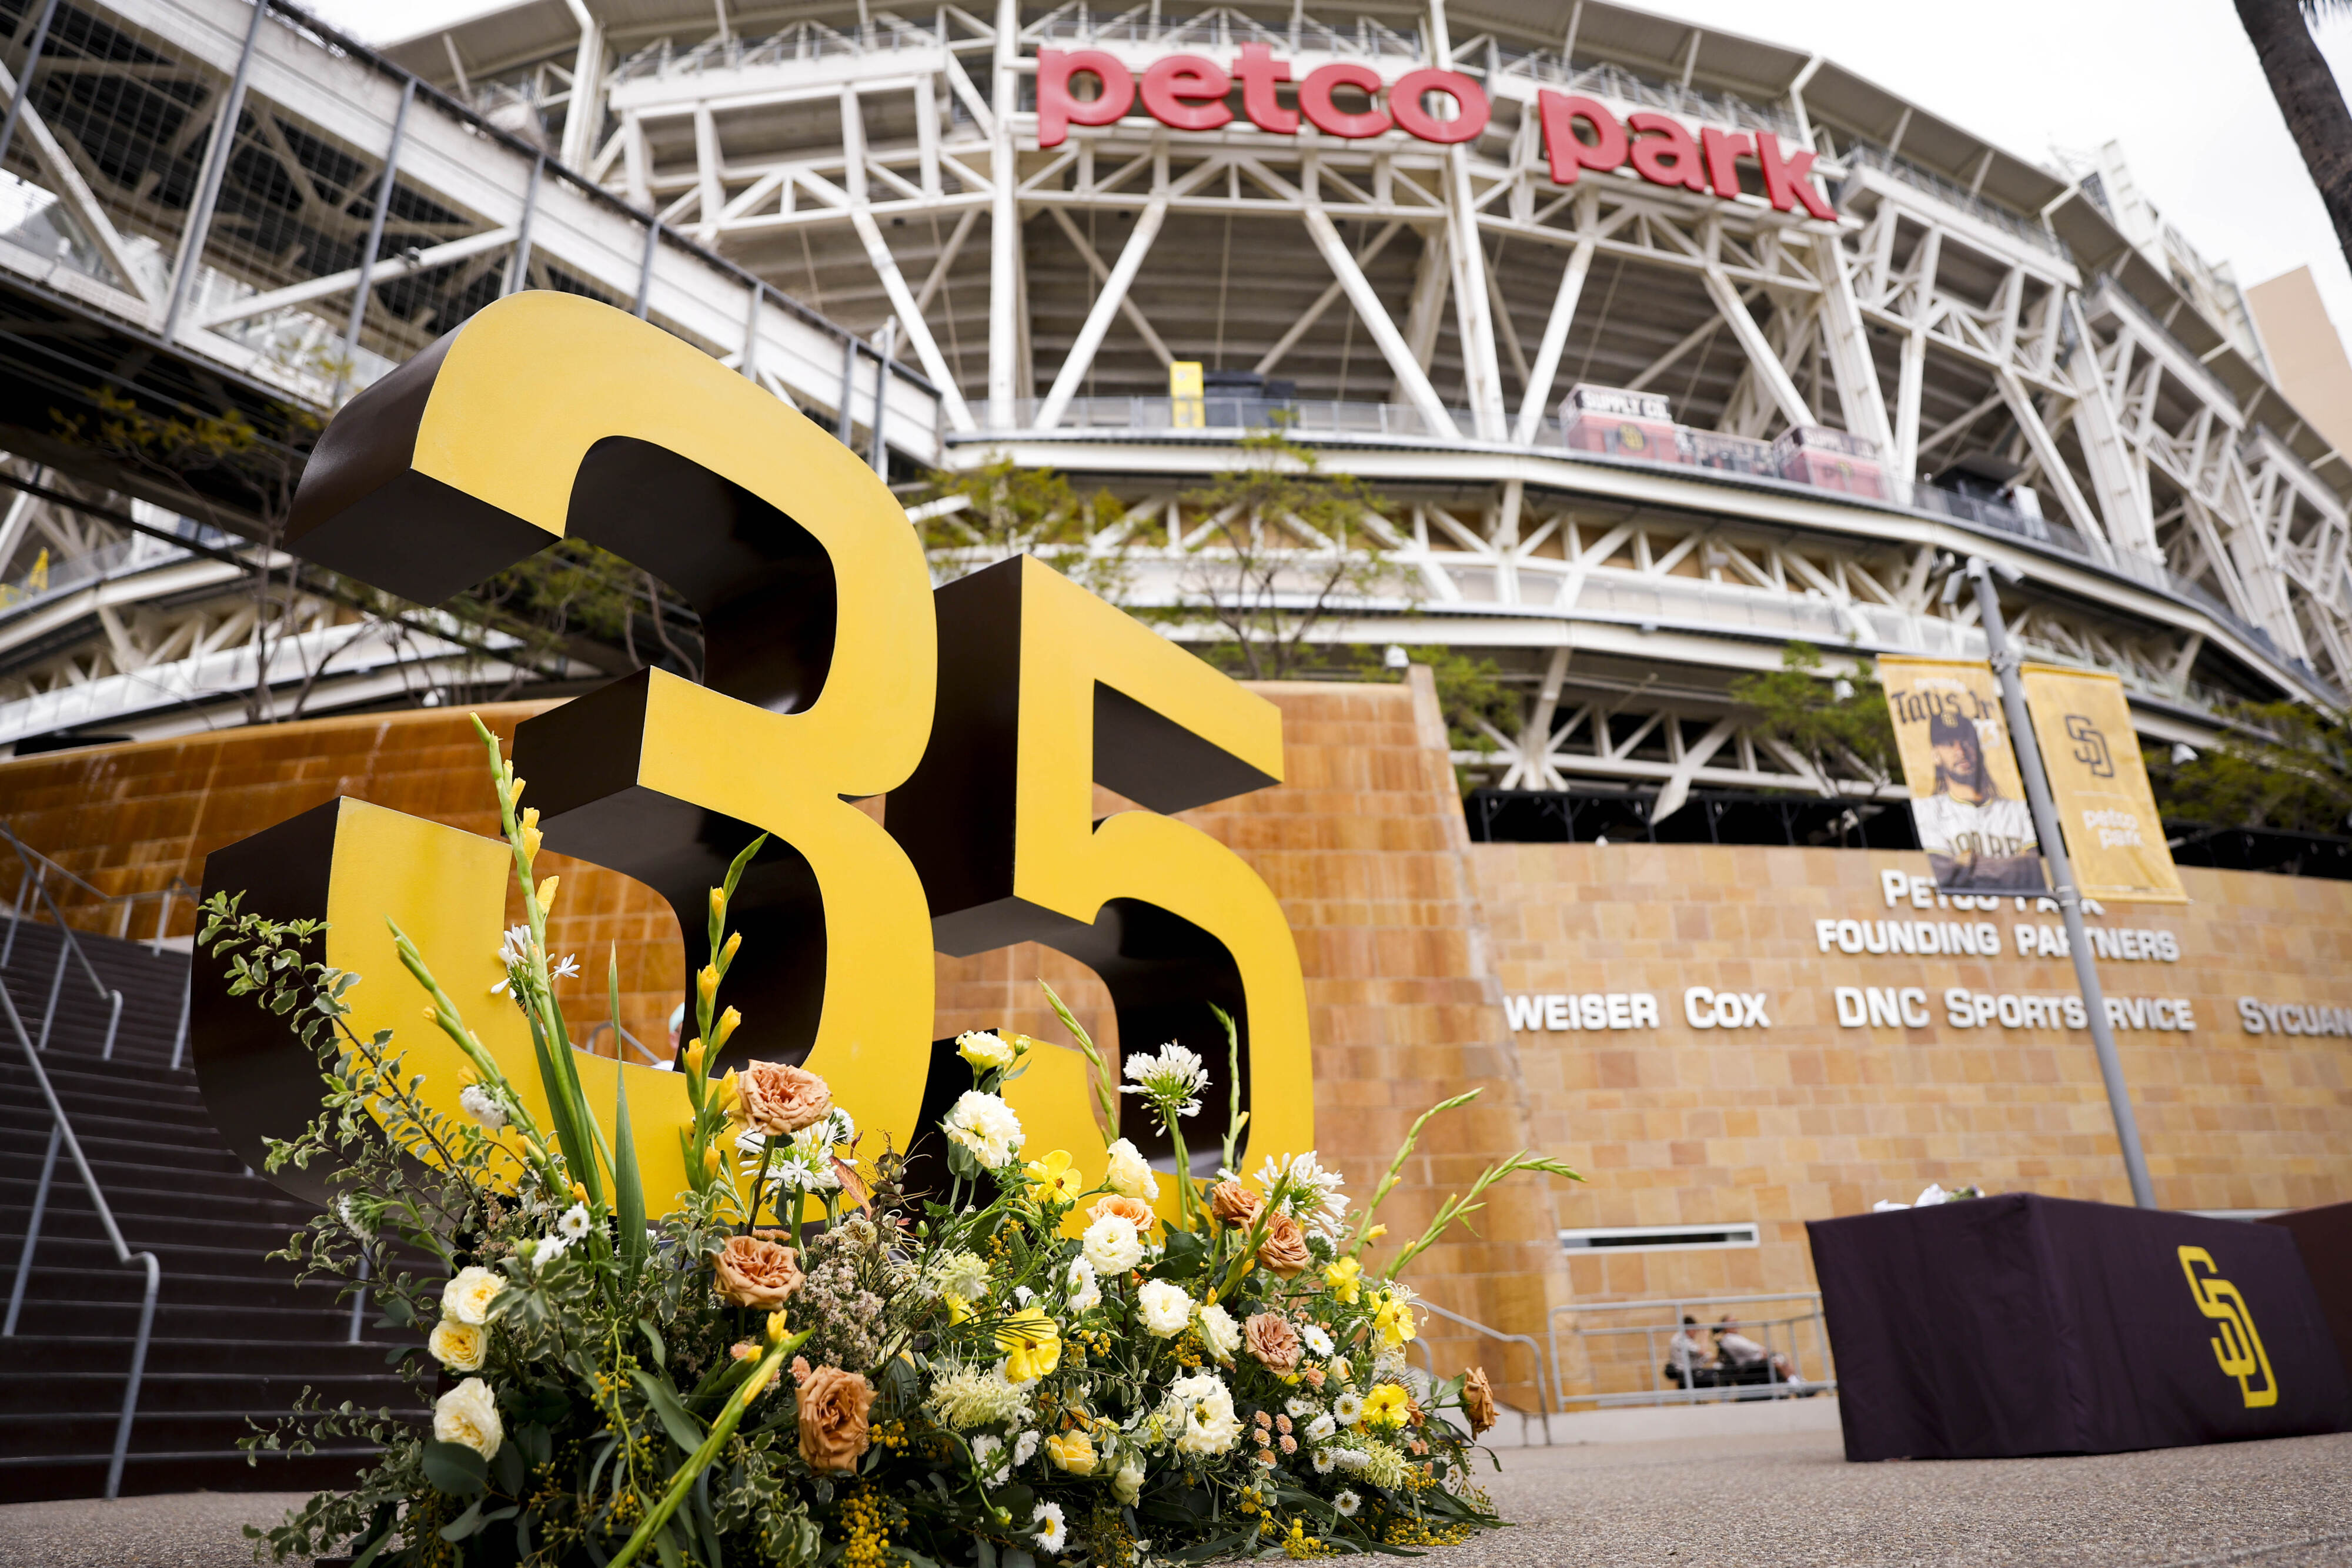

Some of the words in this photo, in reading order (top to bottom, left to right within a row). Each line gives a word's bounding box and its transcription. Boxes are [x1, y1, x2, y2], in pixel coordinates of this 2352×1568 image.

[1036, 41, 1492, 149] petco
[1538, 88, 1838, 222] park
[326, 290, 1315, 1235] 35
[1816, 919, 2000, 956] FOUNDING
[1503, 992, 1661, 1031] WEISER
[1835, 986, 1930, 1028] DNC
[1944, 987, 2197, 1032] SPORTSRVICE
